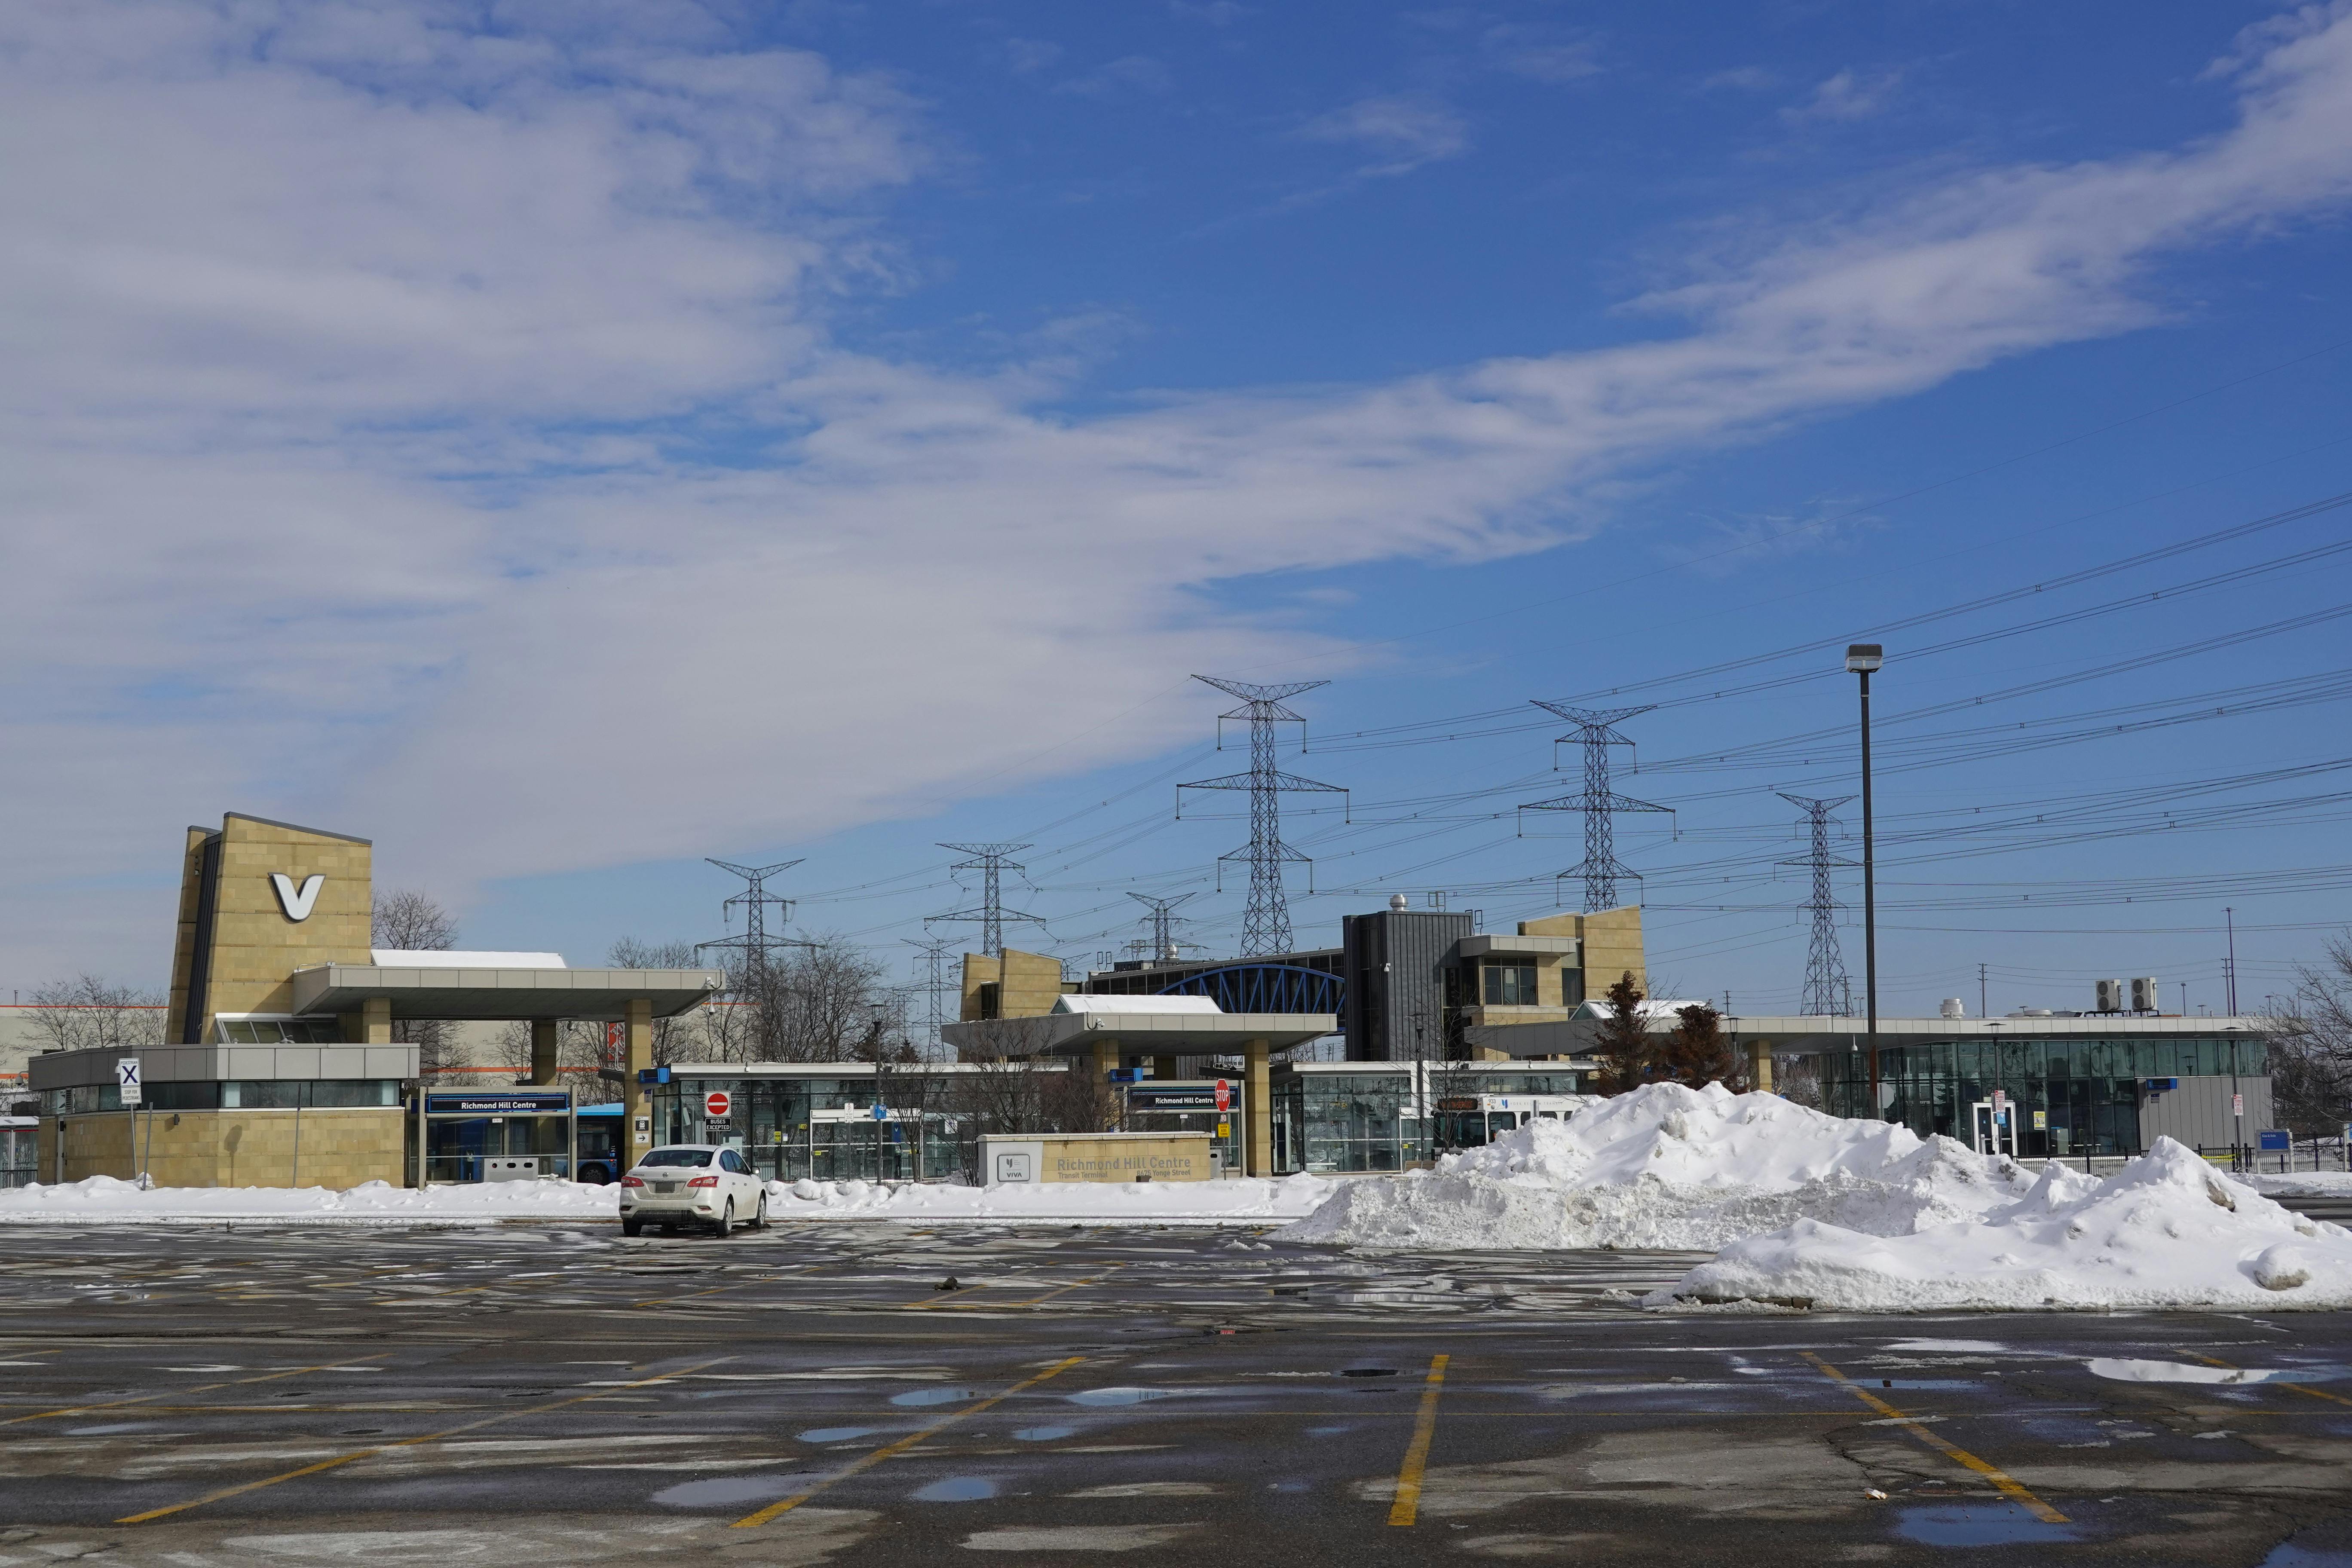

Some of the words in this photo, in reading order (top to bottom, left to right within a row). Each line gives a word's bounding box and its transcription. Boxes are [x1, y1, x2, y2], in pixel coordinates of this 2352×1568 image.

[271, 873, 326, 920] V
[122, 1066, 138, 1083] X
[1216, 1090, 1228, 1102] STOP
[1058, 1158, 1119, 1170] Richmond
[1124, 1157, 1146, 1169] Hill
[1150, 1156, 1190, 1168] Centre
